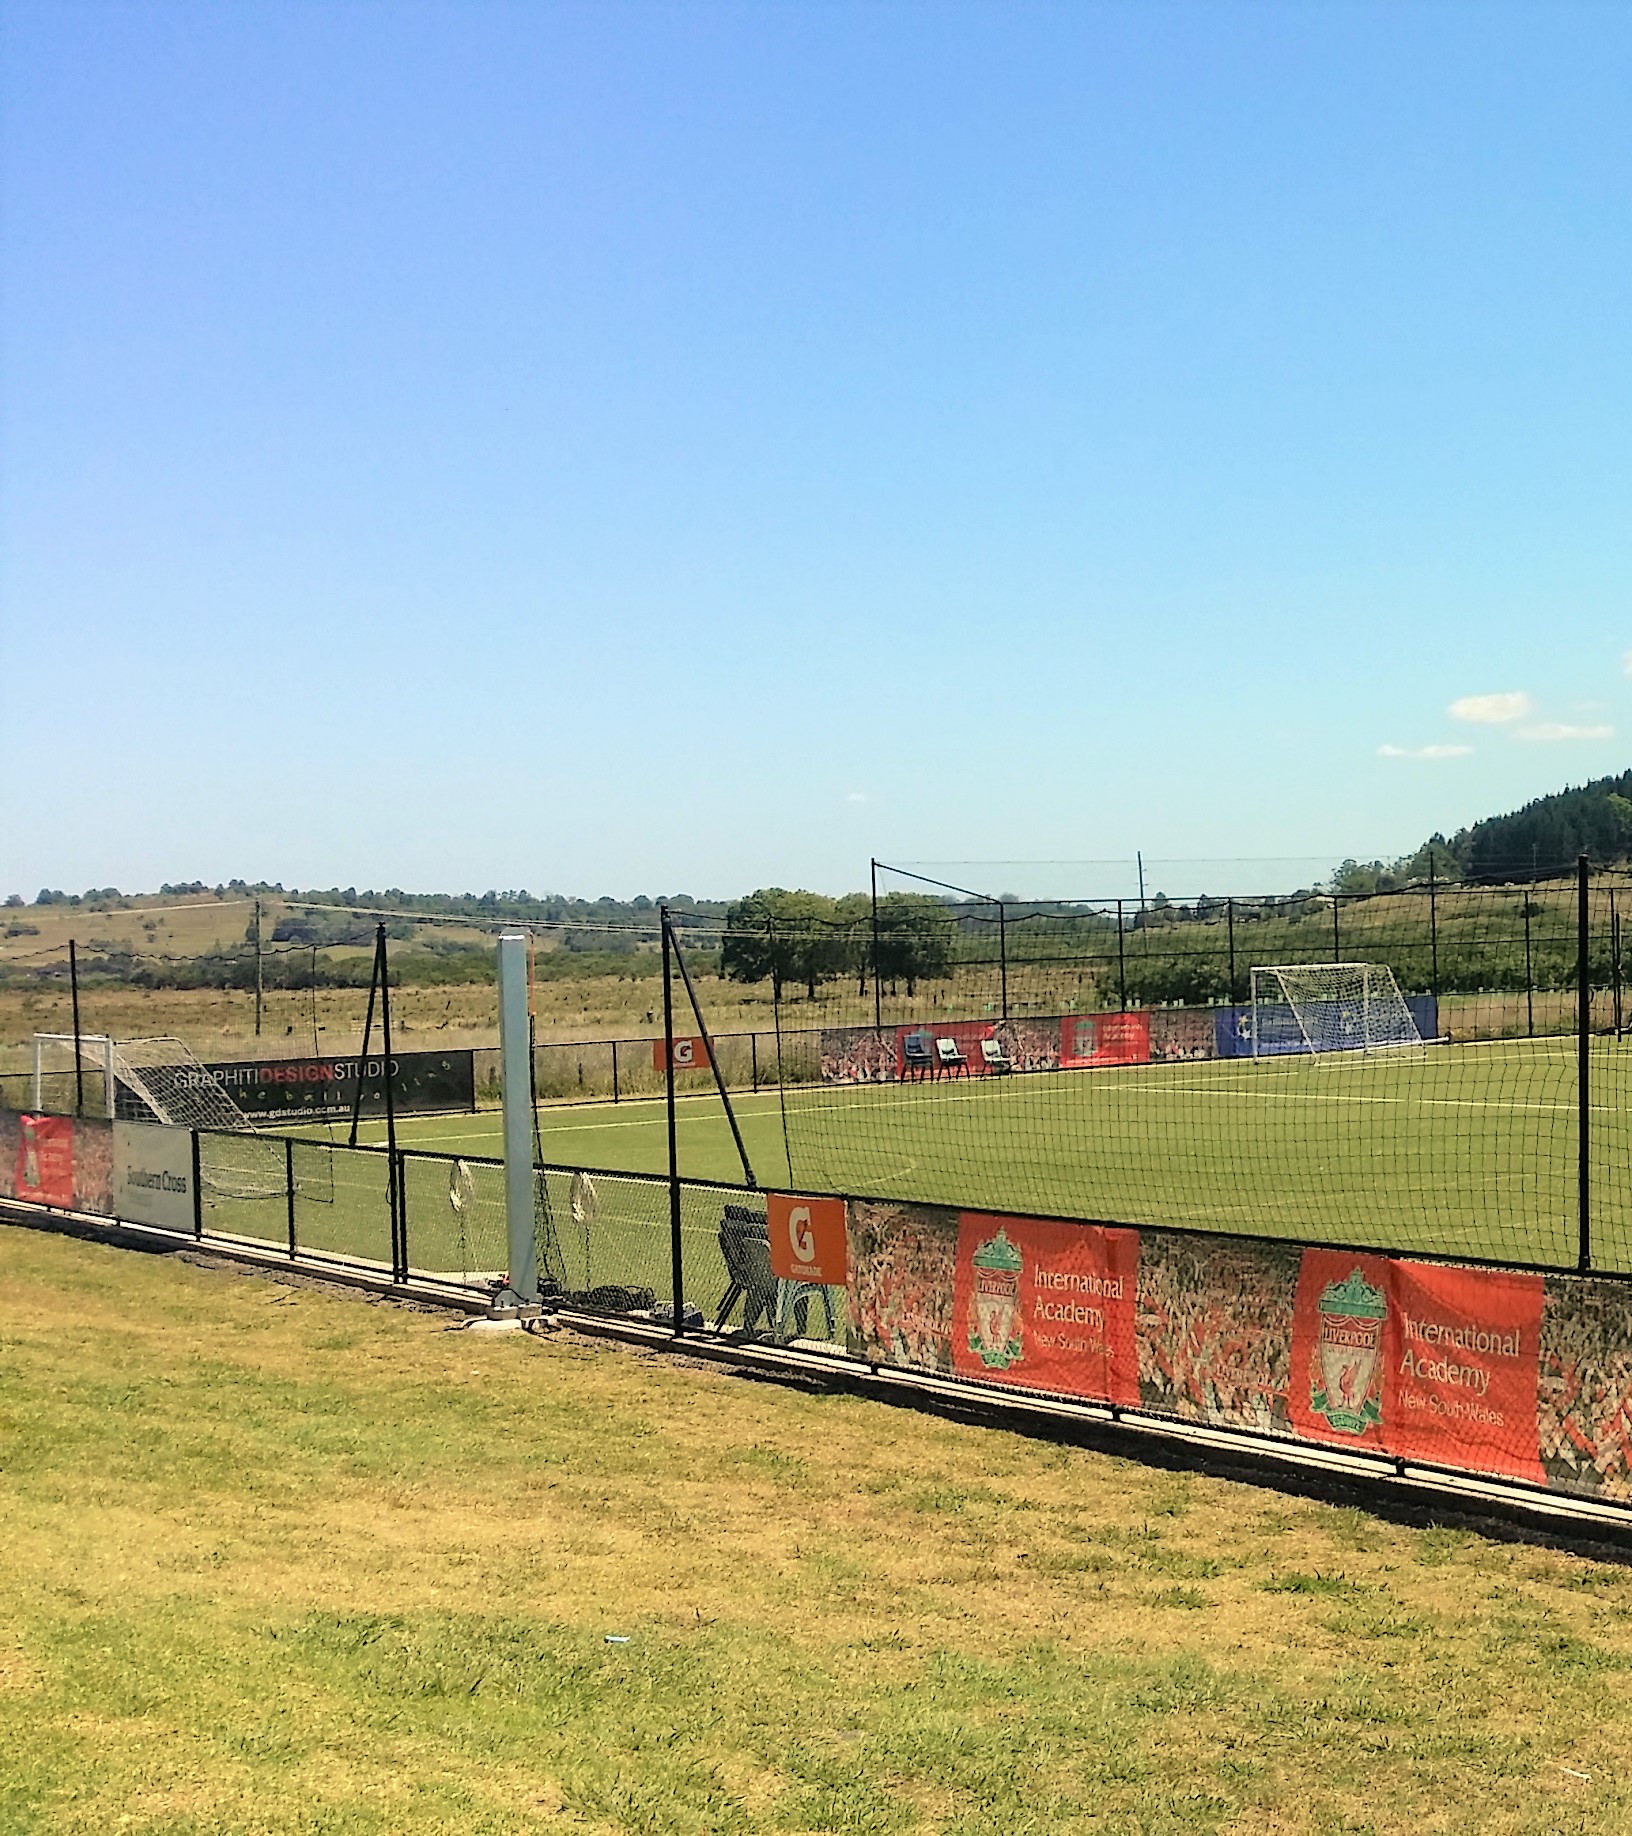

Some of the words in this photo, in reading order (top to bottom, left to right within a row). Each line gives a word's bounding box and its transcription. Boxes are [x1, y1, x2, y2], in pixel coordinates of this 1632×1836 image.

[674, 1040, 692, 1063] G
[162, 1170, 187, 1194] Cross
[789, 1206, 815, 1262] G
[1033, 1264, 1124, 1300] International
[1034, 1295, 1105, 1332] Academy
[1324, 1325, 1376, 1348] LIVERPOOL
[1403, 1312, 1520, 1358] International
[1399, 1349, 1491, 1397] Academy
[1398, 1390, 1425, 1409] New
[1430, 1394, 1466, 1418] South
[1466, 1403, 1505, 1427] Wales
